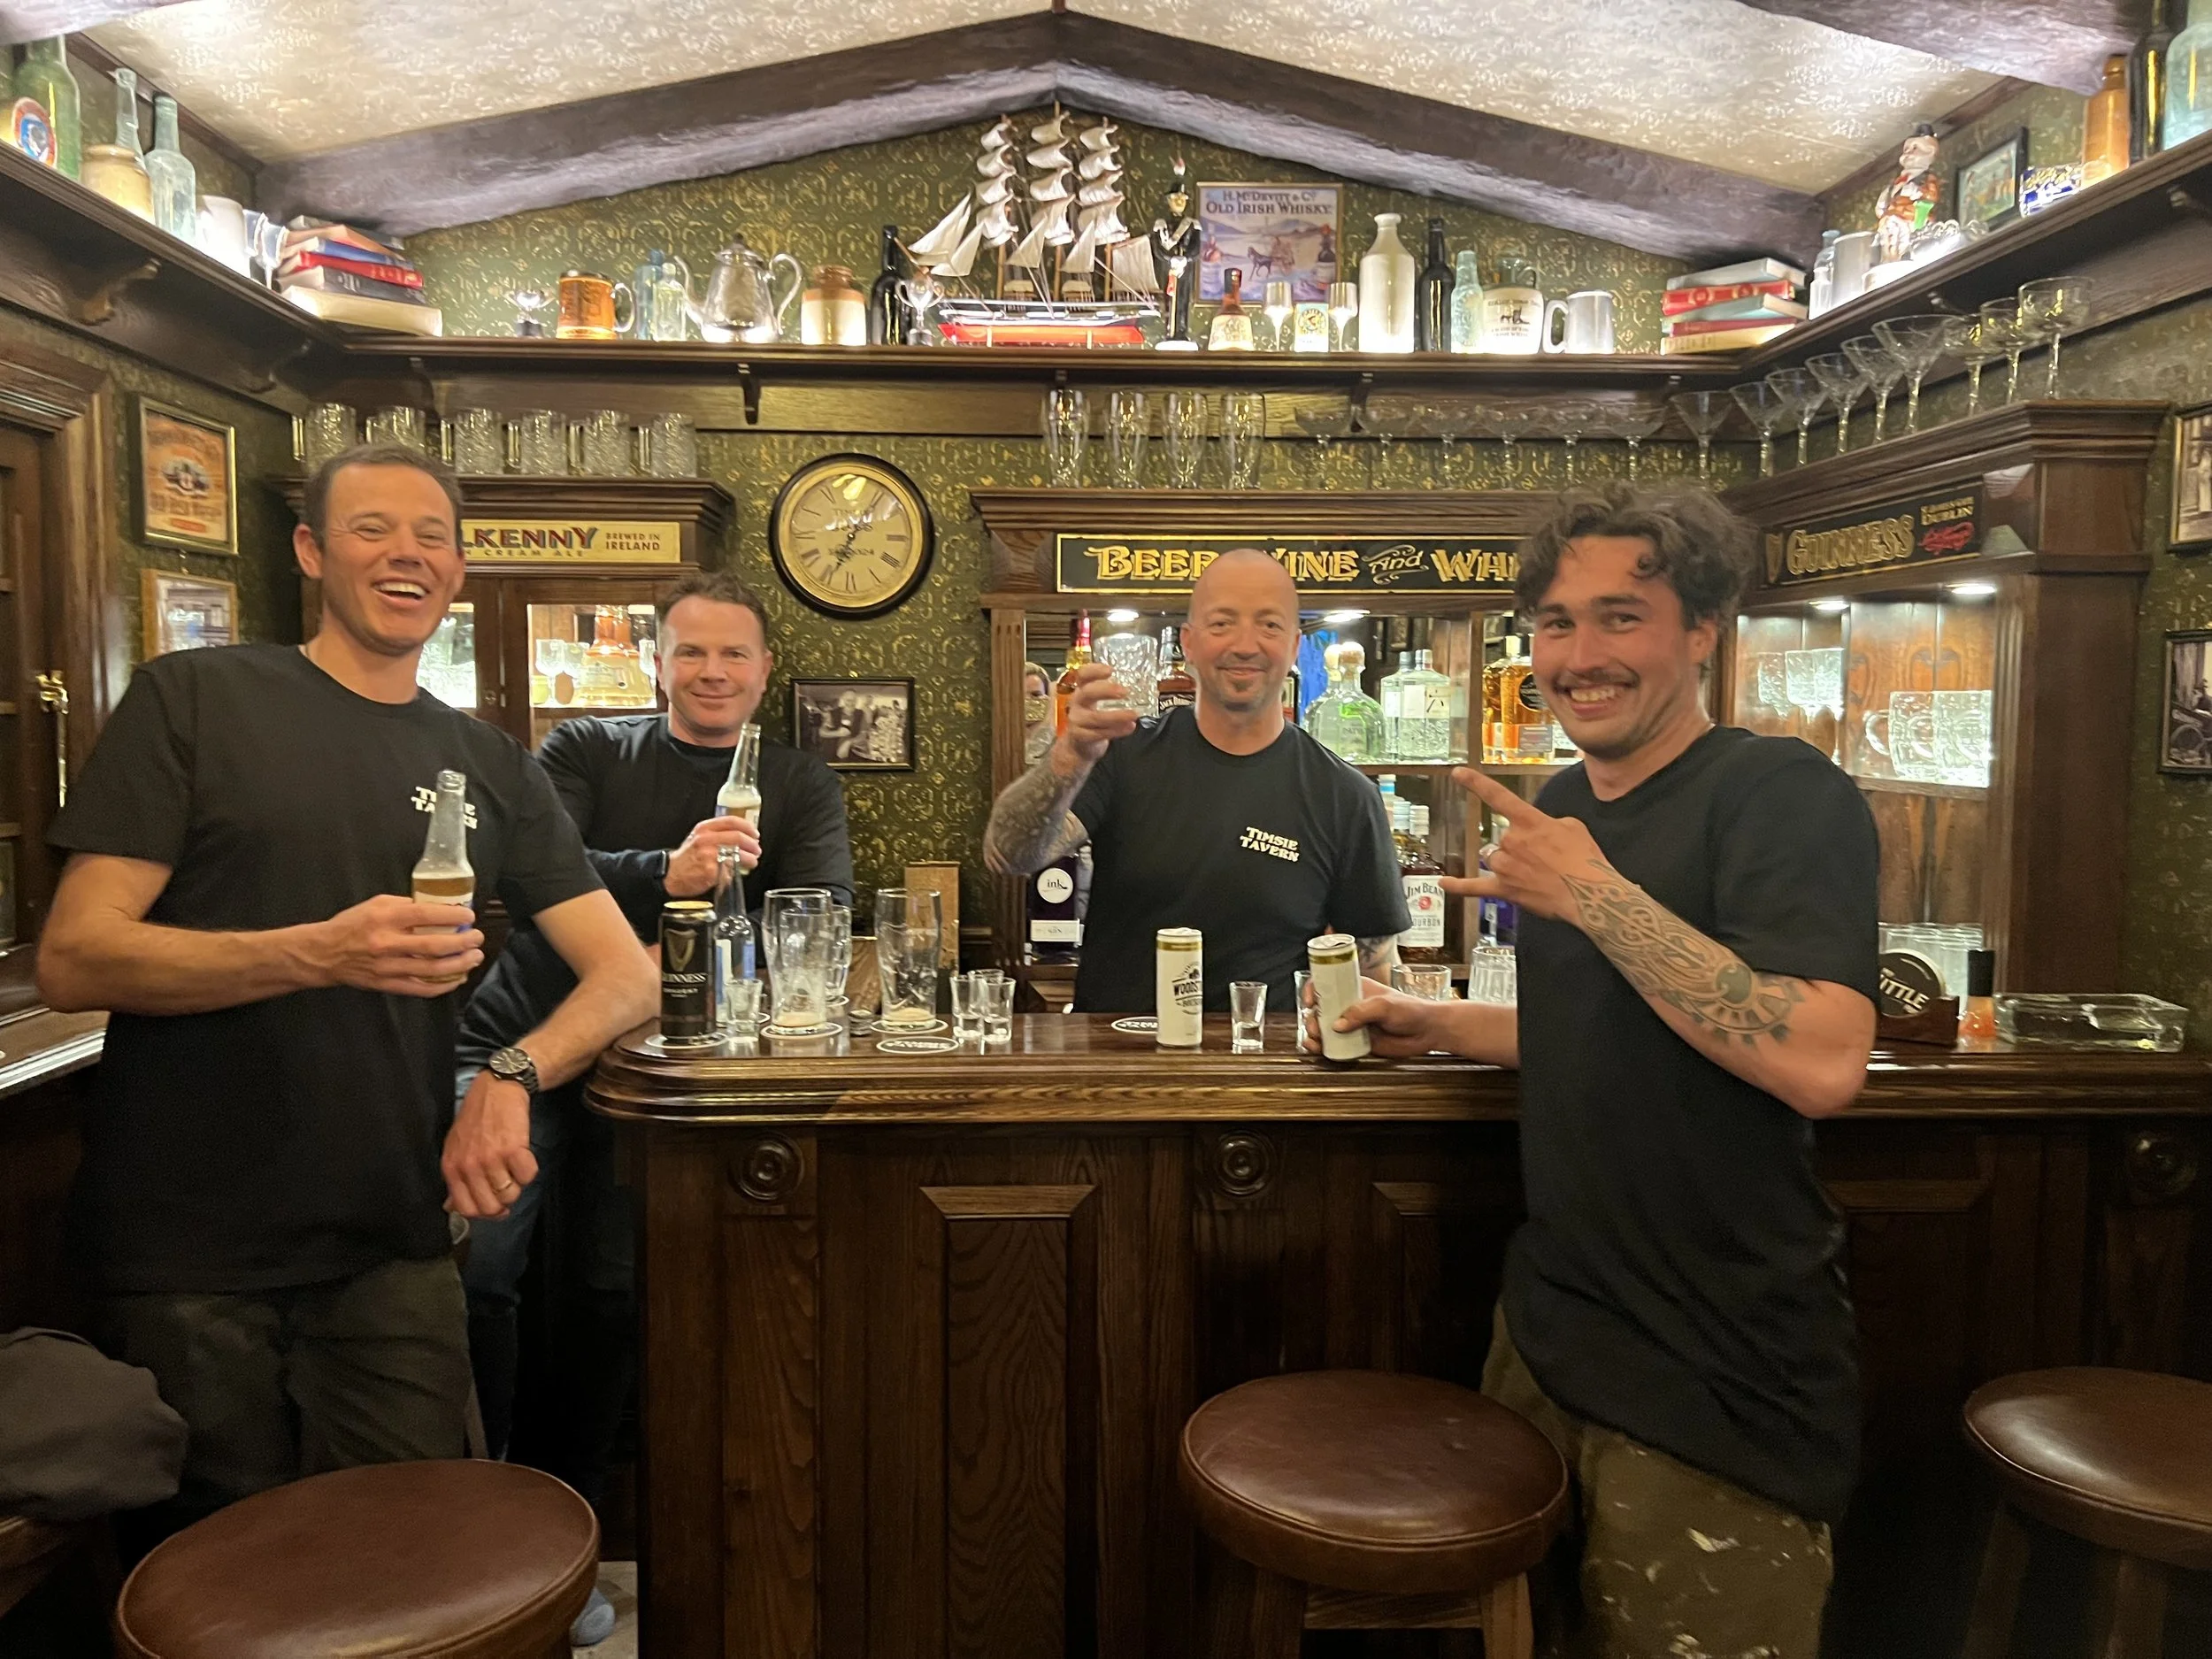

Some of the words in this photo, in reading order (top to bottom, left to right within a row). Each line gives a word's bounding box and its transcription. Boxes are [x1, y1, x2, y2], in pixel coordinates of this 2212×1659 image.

[1206, 201, 1233, 214] OLD
[1238, 199, 1274, 214] IRISH
[605, 532, 646, 541] BREWED
[605, 541, 661, 551] IRELAND
[1786, 514, 1916, 575] GUINNESS
[1083, 545, 1221, 581] BEER
[1264, 547, 1361, 582] INE
[1239, 835, 1300, 863] TAVERN
[1047, 879, 1068, 890] ink
[1408, 886, 1421, 898] JIM
[1411, 917, 1441, 927] OURBON
